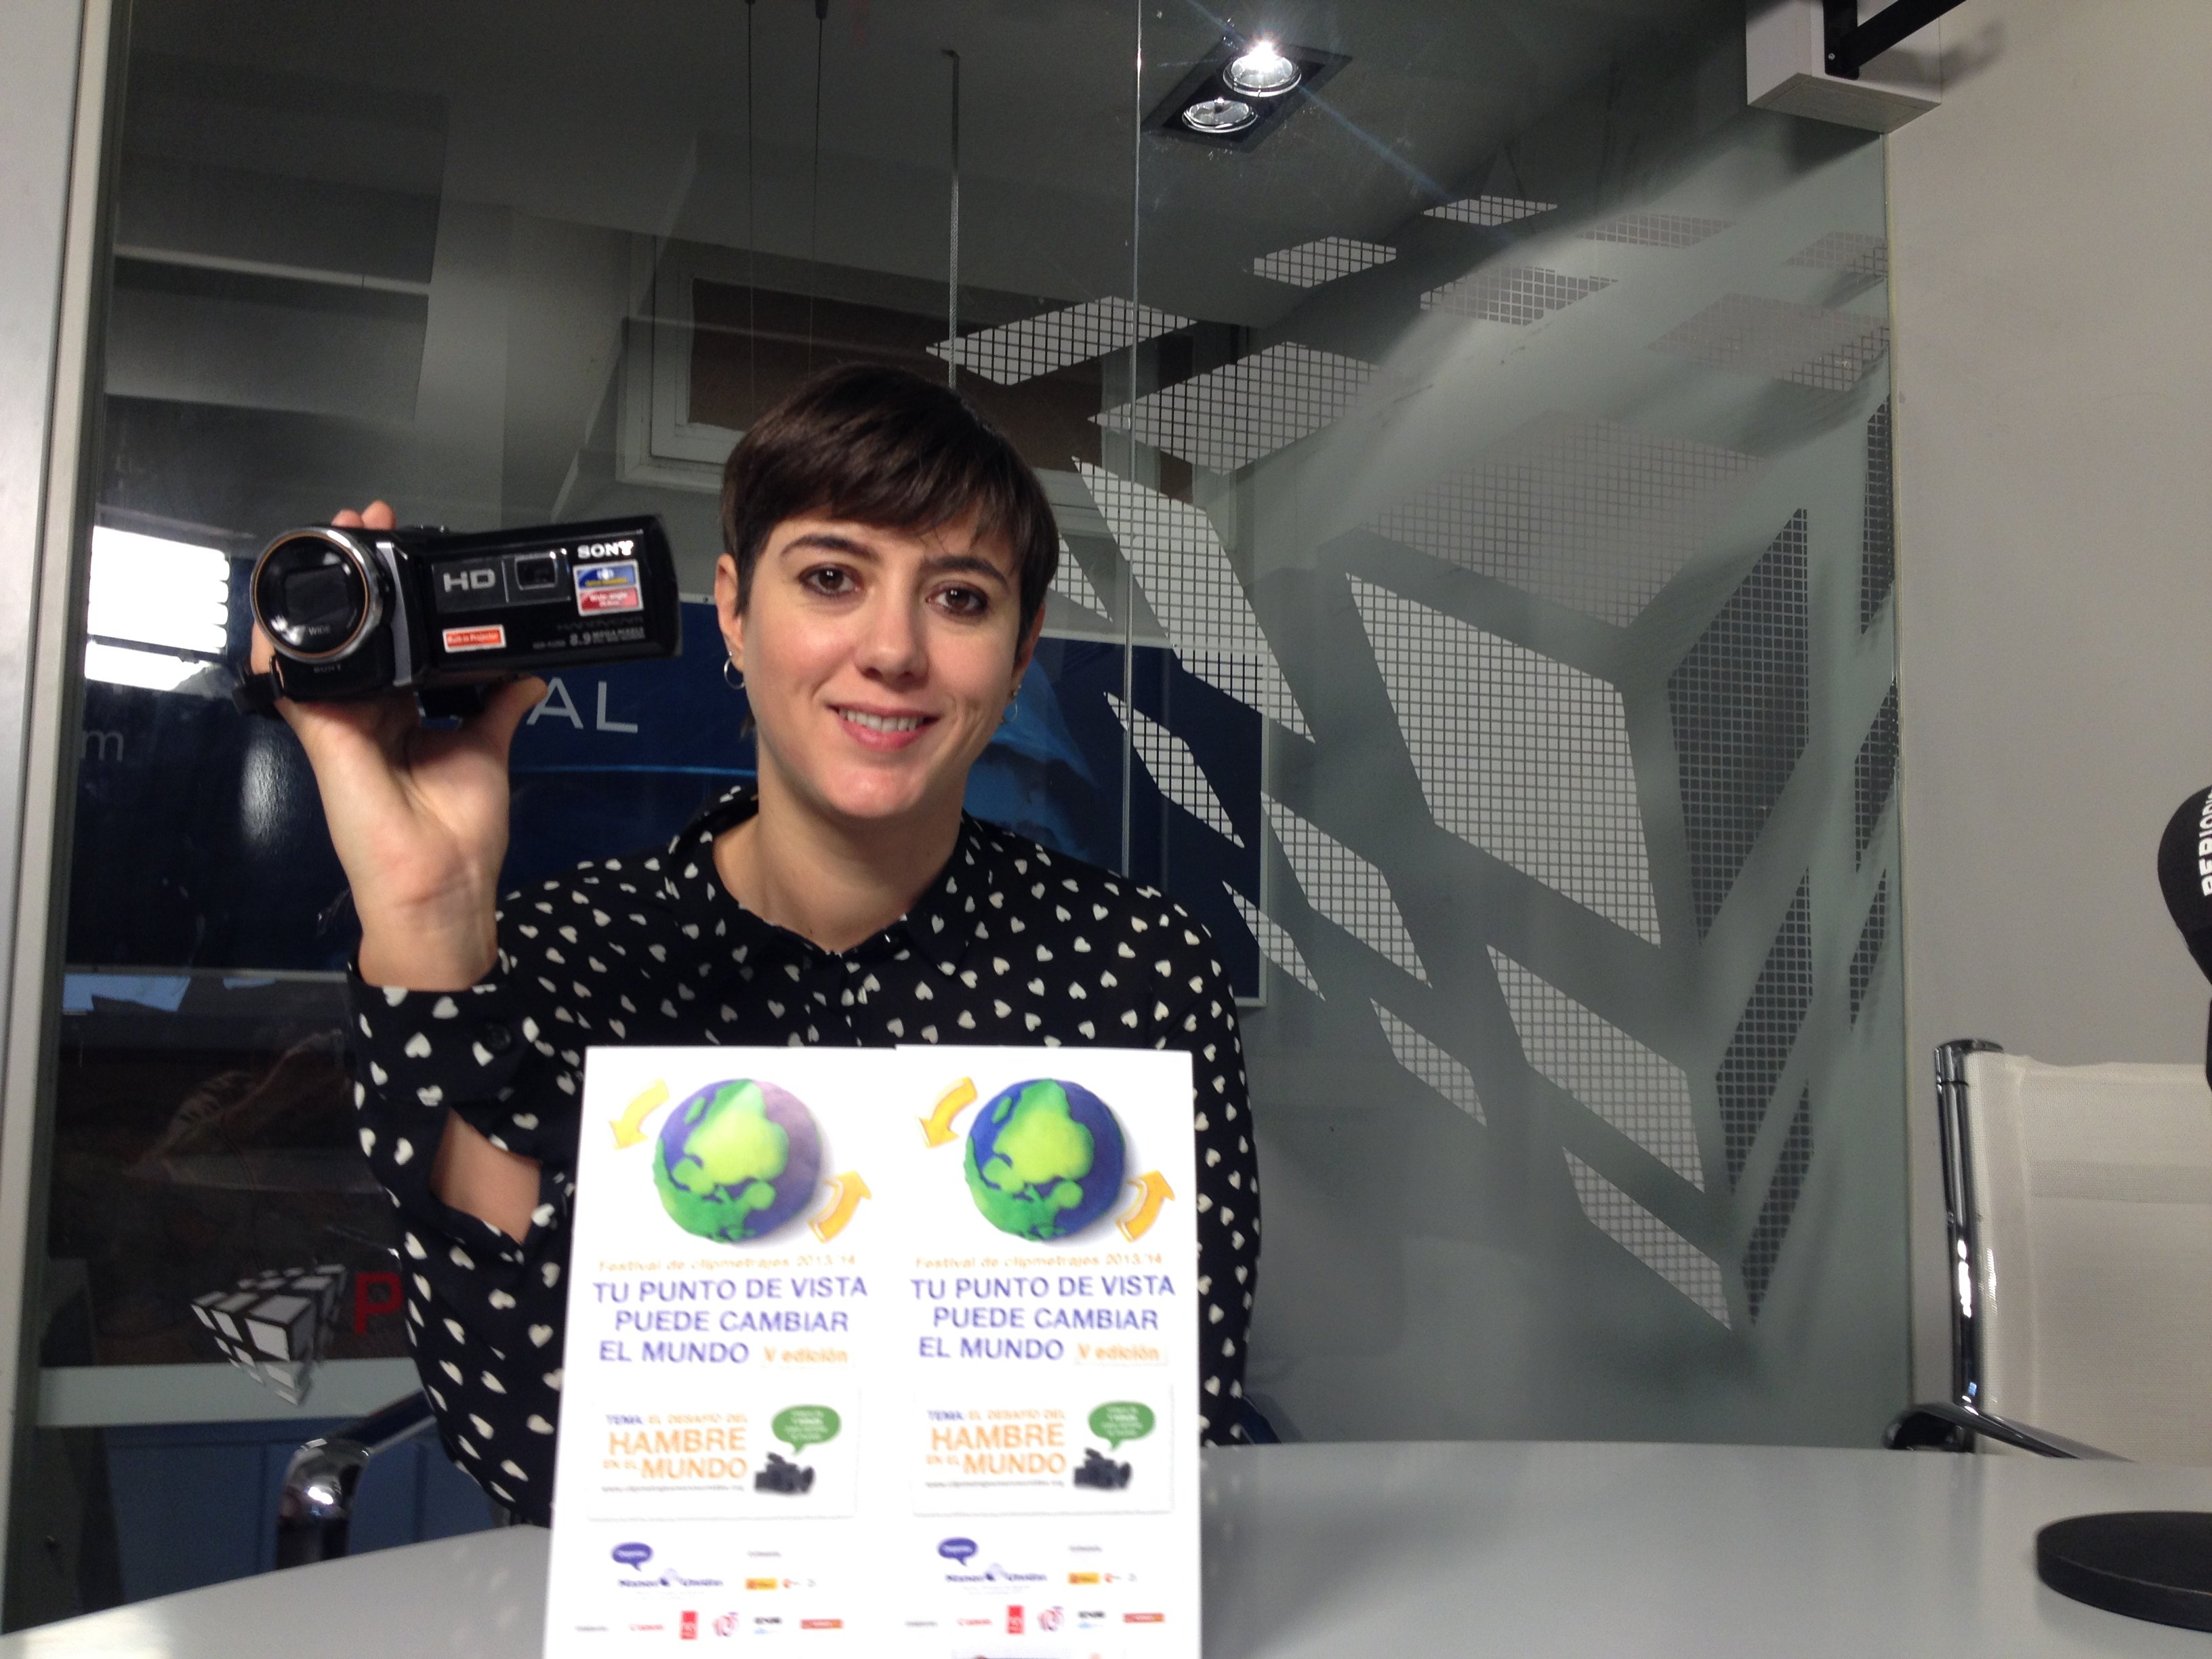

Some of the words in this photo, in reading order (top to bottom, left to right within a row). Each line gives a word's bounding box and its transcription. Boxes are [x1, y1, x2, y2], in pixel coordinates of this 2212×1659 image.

[577, 540, 634, 559] SONY
[443, 569, 495, 592] HD
[593, 1283, 629, 1303] TU
[640, 1279, 737, 1302] PUNTO
[746, 1278, 781, 1299] DE
[791, 1277, 867, 1298] VISTA
[911, 1279, 945, 1300] TU
[956, 1277, 1049, 1298] PUNTO
[1059, 1276, 1093, 1297] DE
[1101, 1275, 1175, 1296] VISTA
[615, 1310, 709, 1332] PUEDE
[720, 1311, 848, 1332] CAMBIAR
[934, 1307, 1024, 1328] PUEDE
[1034, 1308, 1158, 1330] CAMBIAR
[600, 1340, 632, 1361] EL
[642, 1341, 749, 1364] MUNDO
[919, 1336, 950, 1357] EL
[960, 1337, 1064, 1360] MUNDO
[609, 1427, 746, 1456] HAMBRE
[932, 1423, 1065, 1450] HAMBRE
[641, 1458, 748, 1479] MUNDO
[962, 1452, 1067, 1475] MUNDO
